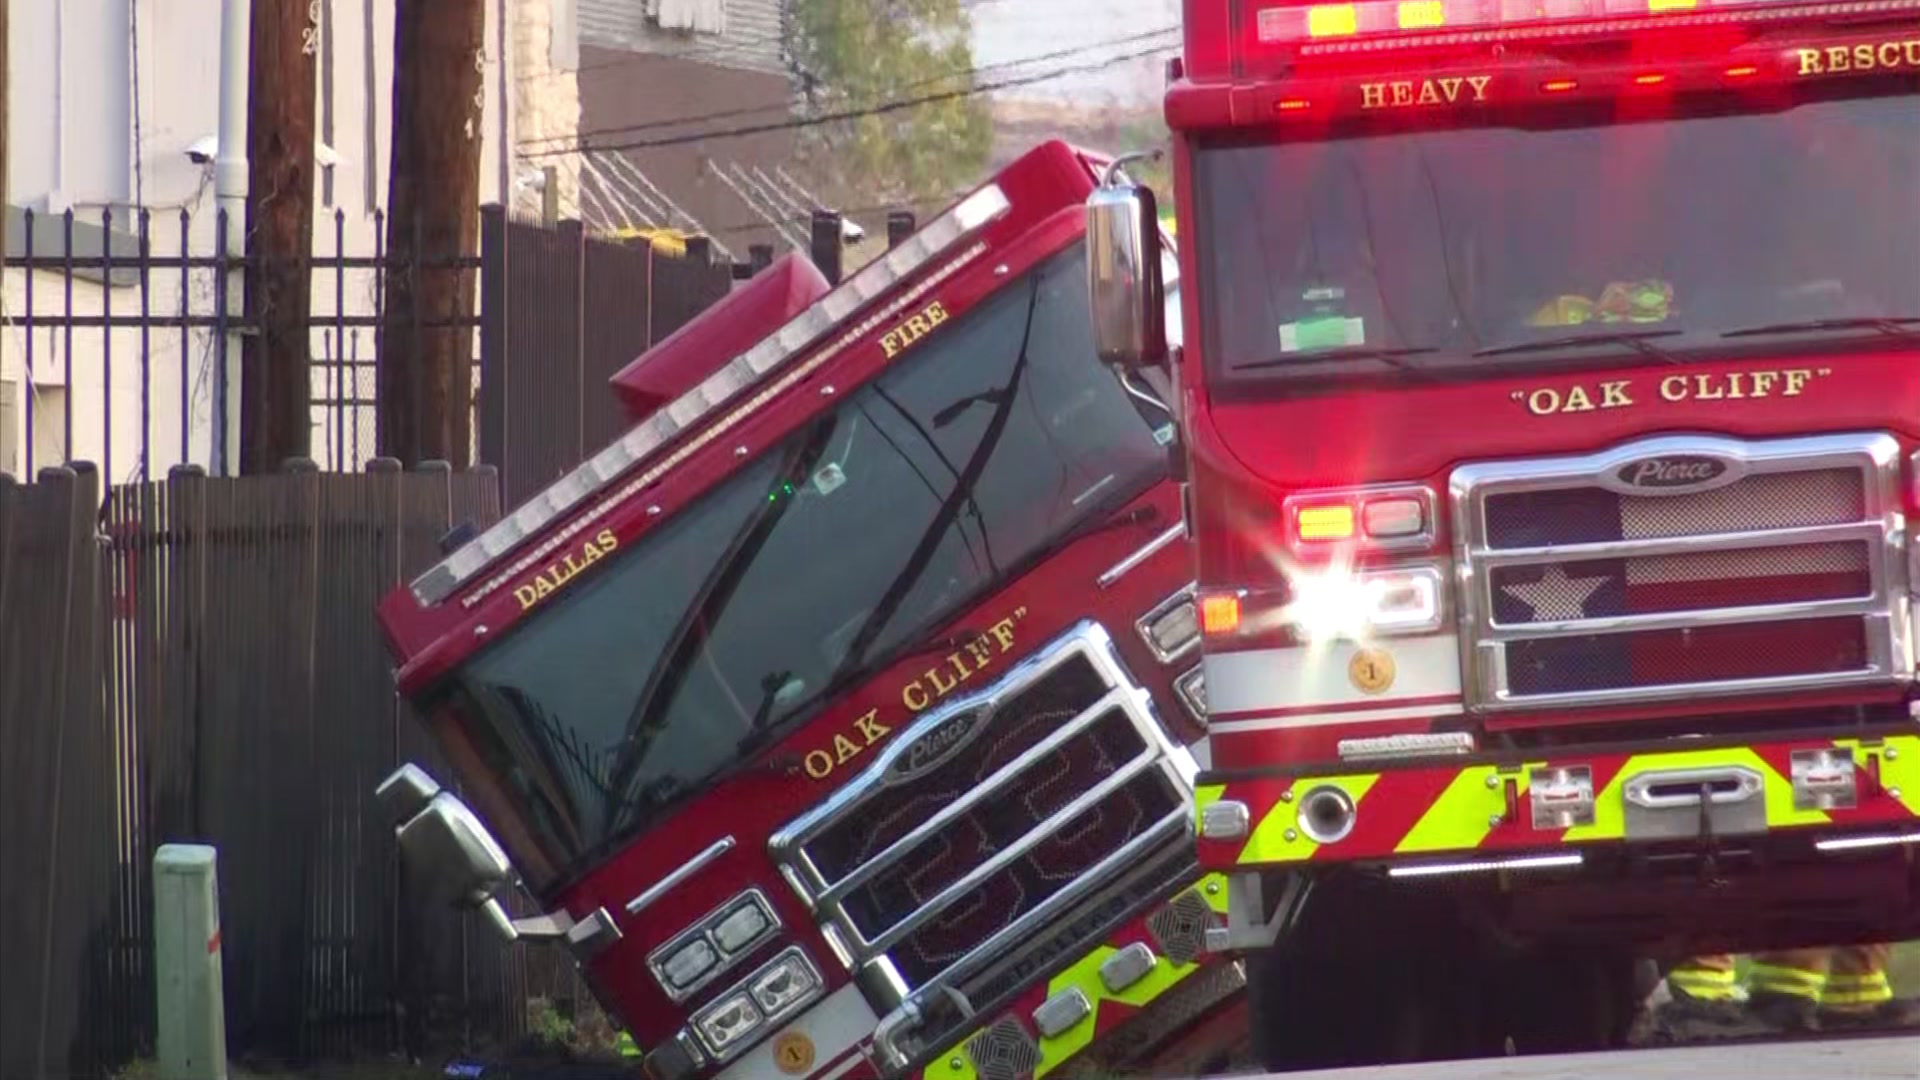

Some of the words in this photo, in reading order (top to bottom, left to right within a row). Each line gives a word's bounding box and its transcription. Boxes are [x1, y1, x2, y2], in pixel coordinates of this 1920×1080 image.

[1360, 75, 1492, 109] HEAVY
[1797, 41, 1920, 75] RESCU
[513, 528, 618, 610] DALLAS
[877, 300, 949, 358] FIRE
[1632, 459, 1714, 487] Pierce
[909, 718, 972, 770] Pierce
